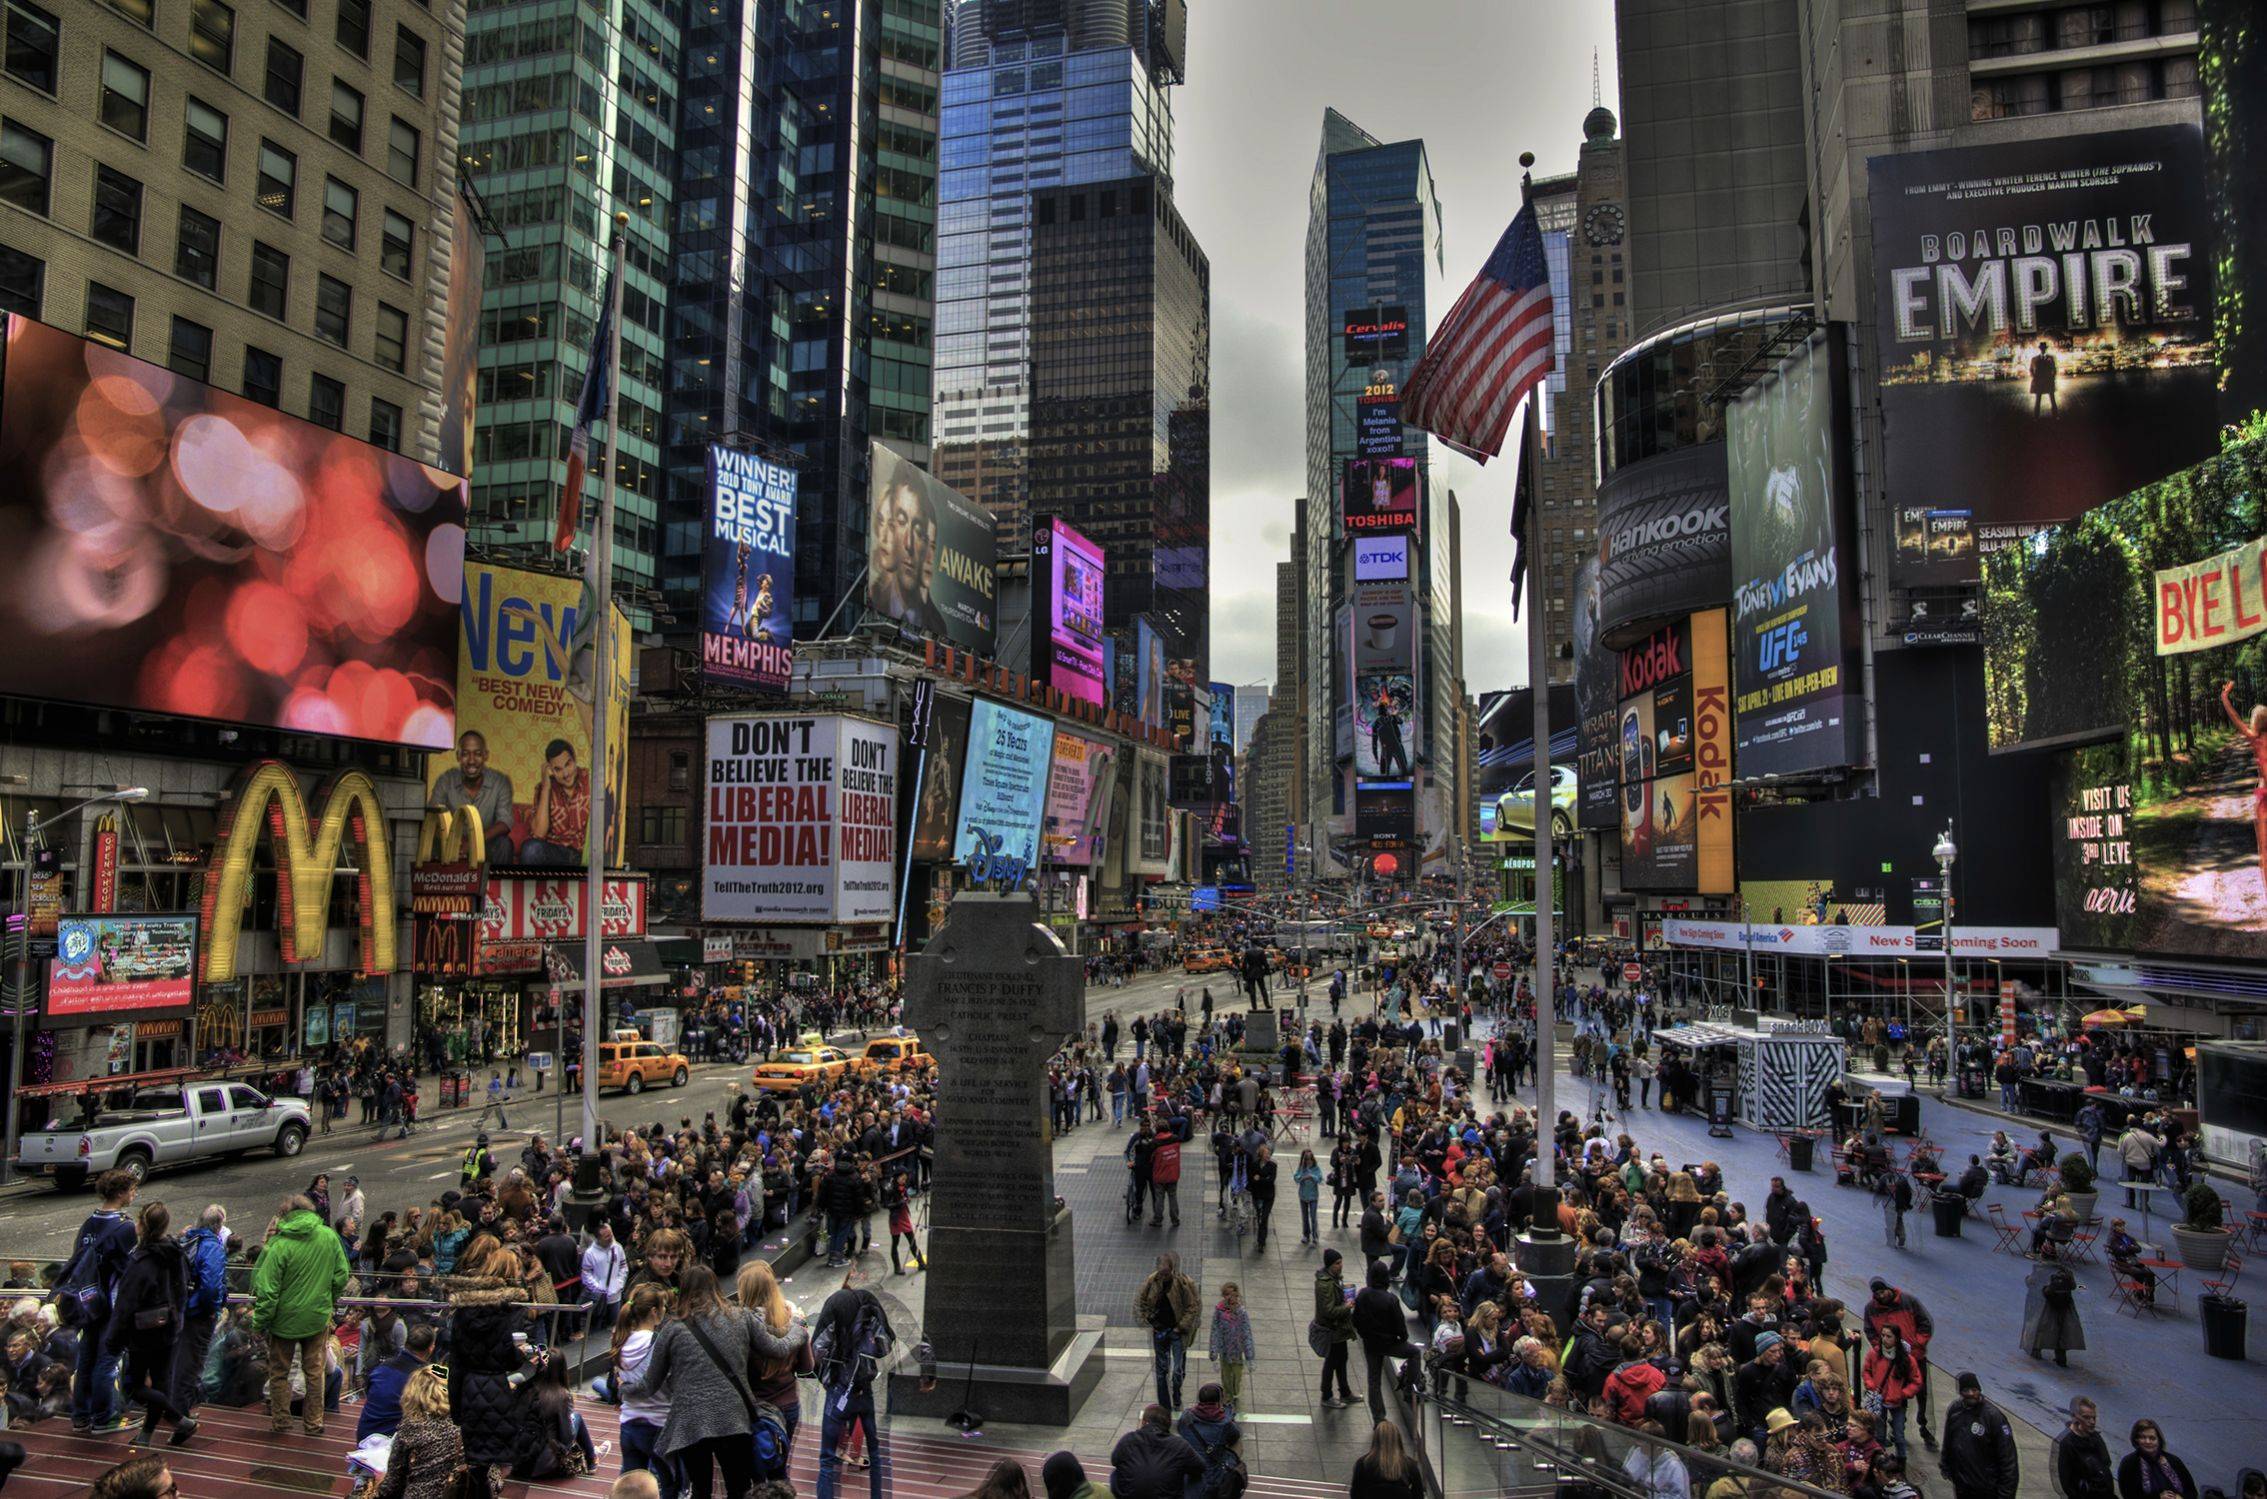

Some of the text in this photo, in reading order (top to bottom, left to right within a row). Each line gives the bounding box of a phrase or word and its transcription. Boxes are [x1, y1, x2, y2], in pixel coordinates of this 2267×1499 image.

[1946, 176, 2119, 200] AND EXECUTIVE PRODUCER MARTIN SCORSESE
[1994, 175, 2023, 186] WRITER
[2026, 172, 2058, 183] TERENCE
[2060, 169, 2091, 180] WINTER
[1921, 214, 2156, 263] BOARDWALK
[1890, 243, 2195, 343] EMPIRE
[1365, 383, 1394, 396] 2012
[1369, 427, 1390, 435] from
[713, 446, 796, 492] WINNER!
[717, 470, 792, 506] 2010 TONY AWARD
[716, 485, 791, 536] BEST
[1346, 513, 1415, 528] TOSHIBA
[715, 519, 791, 558] MUSICAL
[1931, 520, 1968, 533] EMPIRE
[1979, 526, 2016, 540] SEASON
[2017, 525, 2037, 538] ONE
[1035, 546, 1048, 554] LG
[1369, 551, 1403, 564] TDK
[1620, 531, 1728, 565] driving emotion
[939, 545, 993, 600] AWAKE
[1785, 546, 1837, 598] EVANS
[2160, 571, 2226, 646] BYE
[703, 632, 793, 676] MEMPHIS
[1759, 620, 1802, 672] UFC
[1623, 625, 1681, 698] Kodak
[526, 684, 566, 701] NEW
[1747, 689, 1762, 710] APRIL
[1793, 665, 1838, 697] PAY-PER-VIEW
[1174, 708, 1190, 720] LIVE
[1582, 709, 1617, 736] WRATH
[731, 720, 816, 756] DON'T
[995, 728, 1029, 752] 25 Years
[851, 737, 887, 771] DON'T
[1696, 686, 1727, 821] Kodak
[711, 757, 832, 783] BELIEVE THE
[842, 768, 893, 796] BELIEVE THE
[710, 785, 832, 823] LIBERAL
[841, 792, 893, 827] LIBERAL
[2082, 785, 2131, 812] VISIT US
[2067, 814, 2123, 840] INSIDE ON
[708, 825, 831, 867] MEDIA!
[841, 826, 892, 863] MEDIA!
[2081, 841, 2132, 865] 3RD LEVE
[413, 871, 478, 883] McDonald's
[714, 881, 825, 896] TellTheTruth2012.org
[1642, 911, 1720, 920] MARQUIS
[1757, 932, 1778, 944] America
[1869, 935, 1900, 947] New
[2001, 936, 2038, 948] Soon
[937, 982, 987, 994] FRANCIS
[1002, 983, 1044, 995] DUFFY
[1014, 1130, 1041, 1138] GUARD
